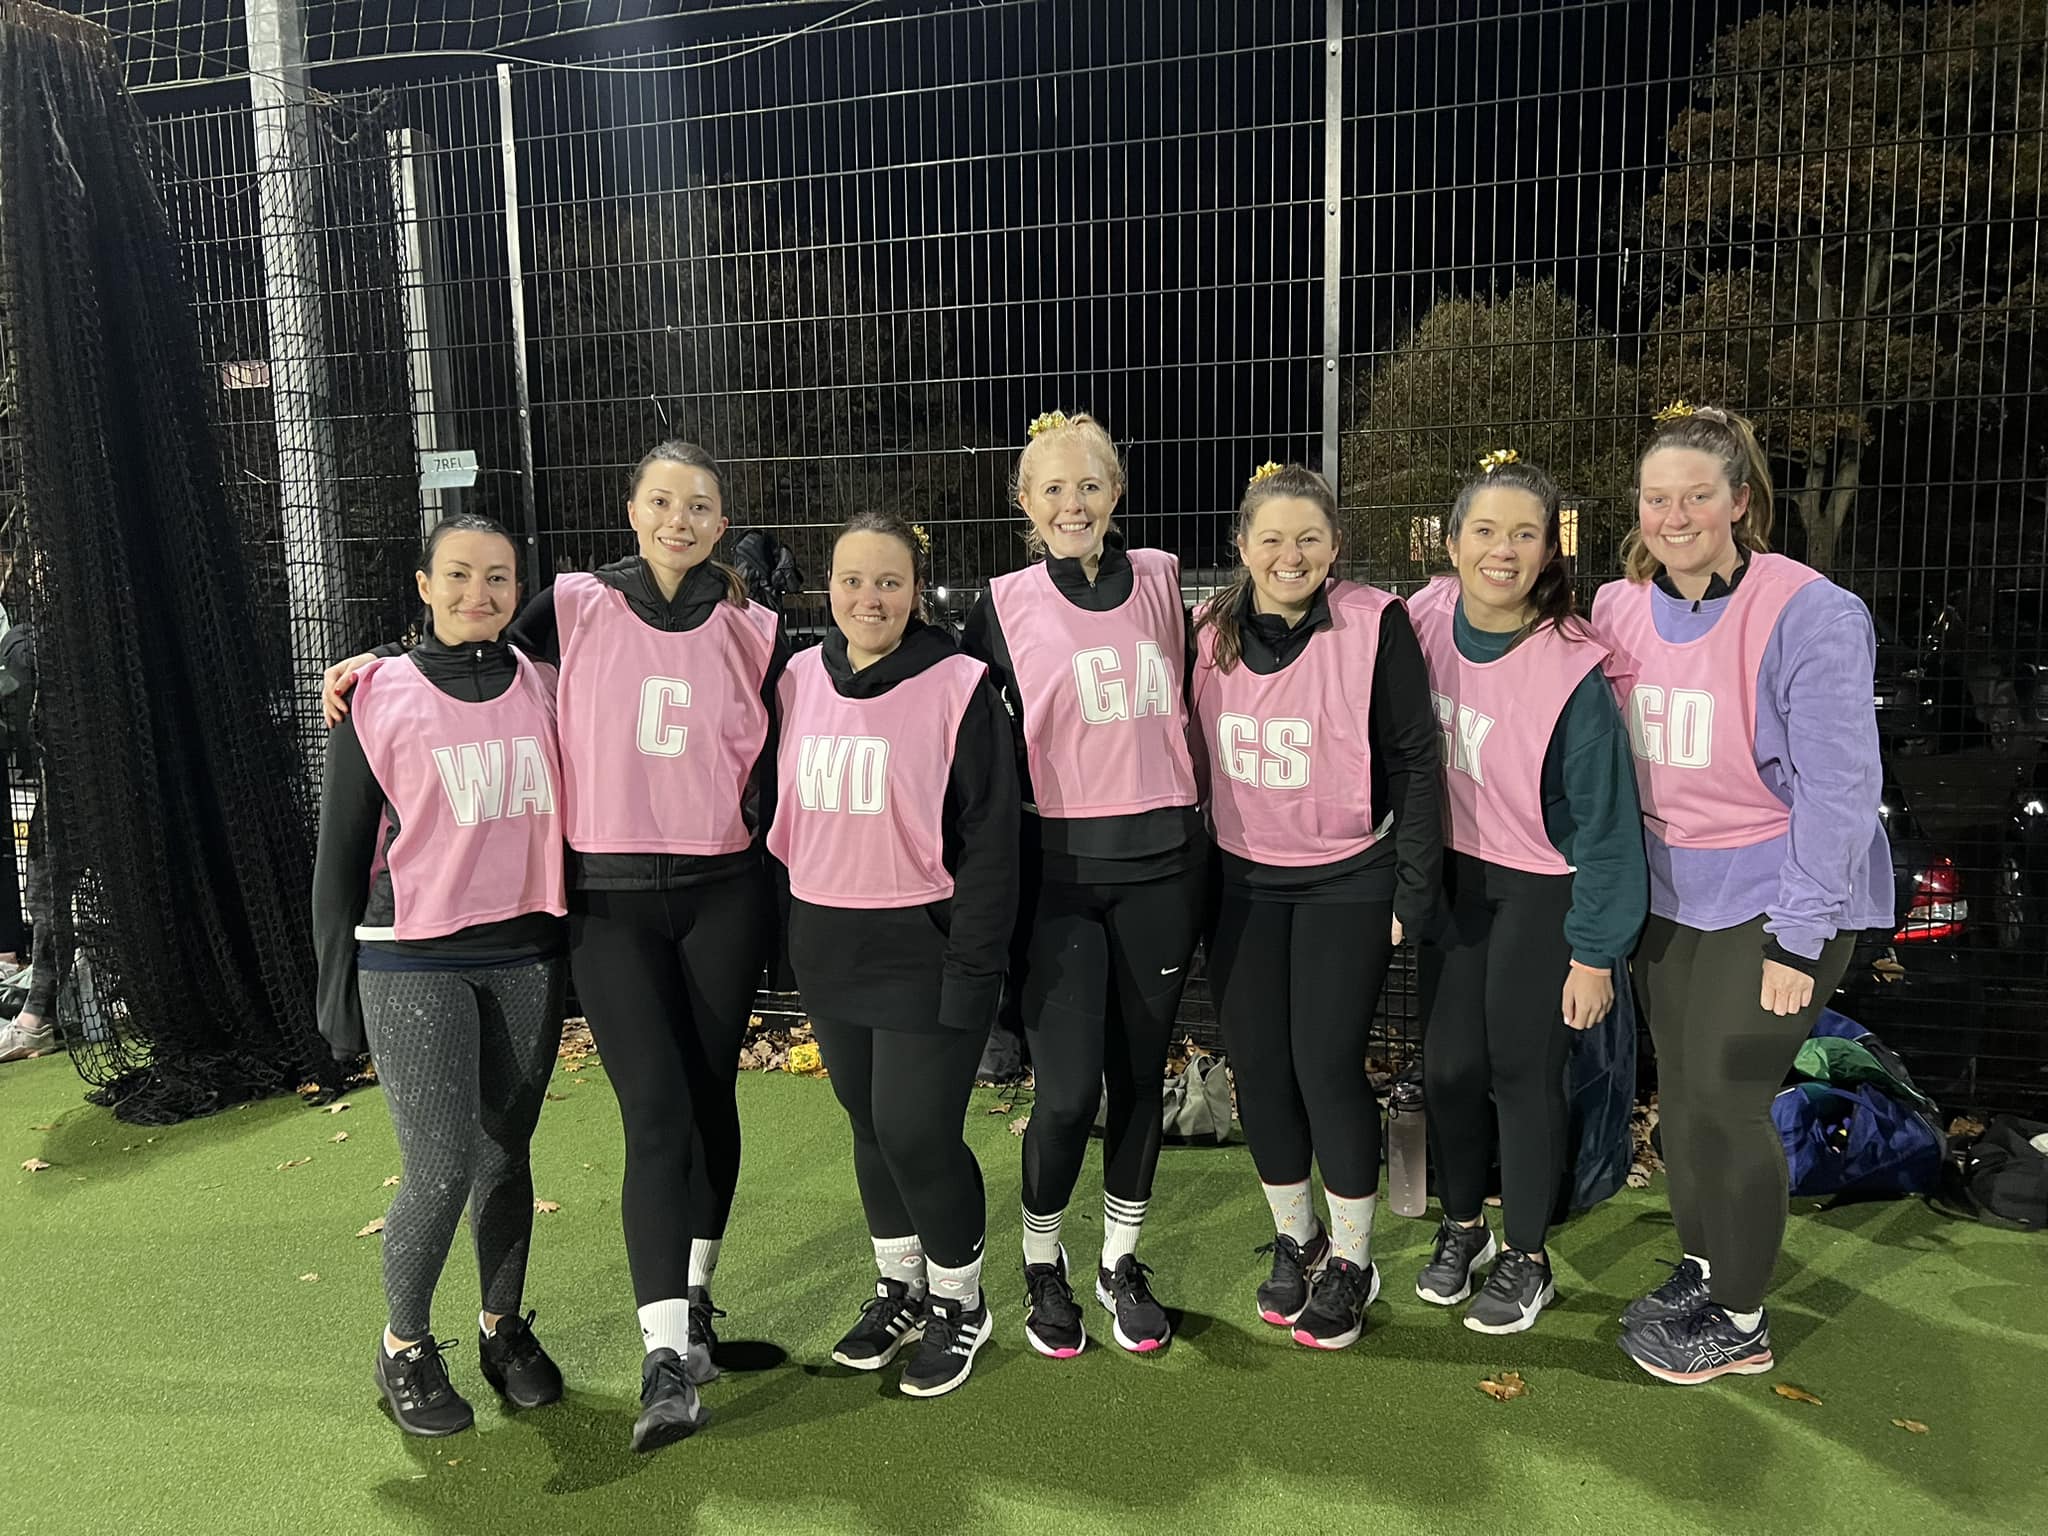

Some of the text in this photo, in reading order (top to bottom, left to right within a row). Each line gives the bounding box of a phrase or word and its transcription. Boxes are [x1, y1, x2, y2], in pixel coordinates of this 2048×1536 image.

[637, 675, 692, 758] C
[1072, 640, 1171, 725] GA
[1217, 711, 1312, 790] GS
[1629, 684, 1715, 769] GD
[431, 735, 555, 827] WA
[796, 735, 889, 815] WD
